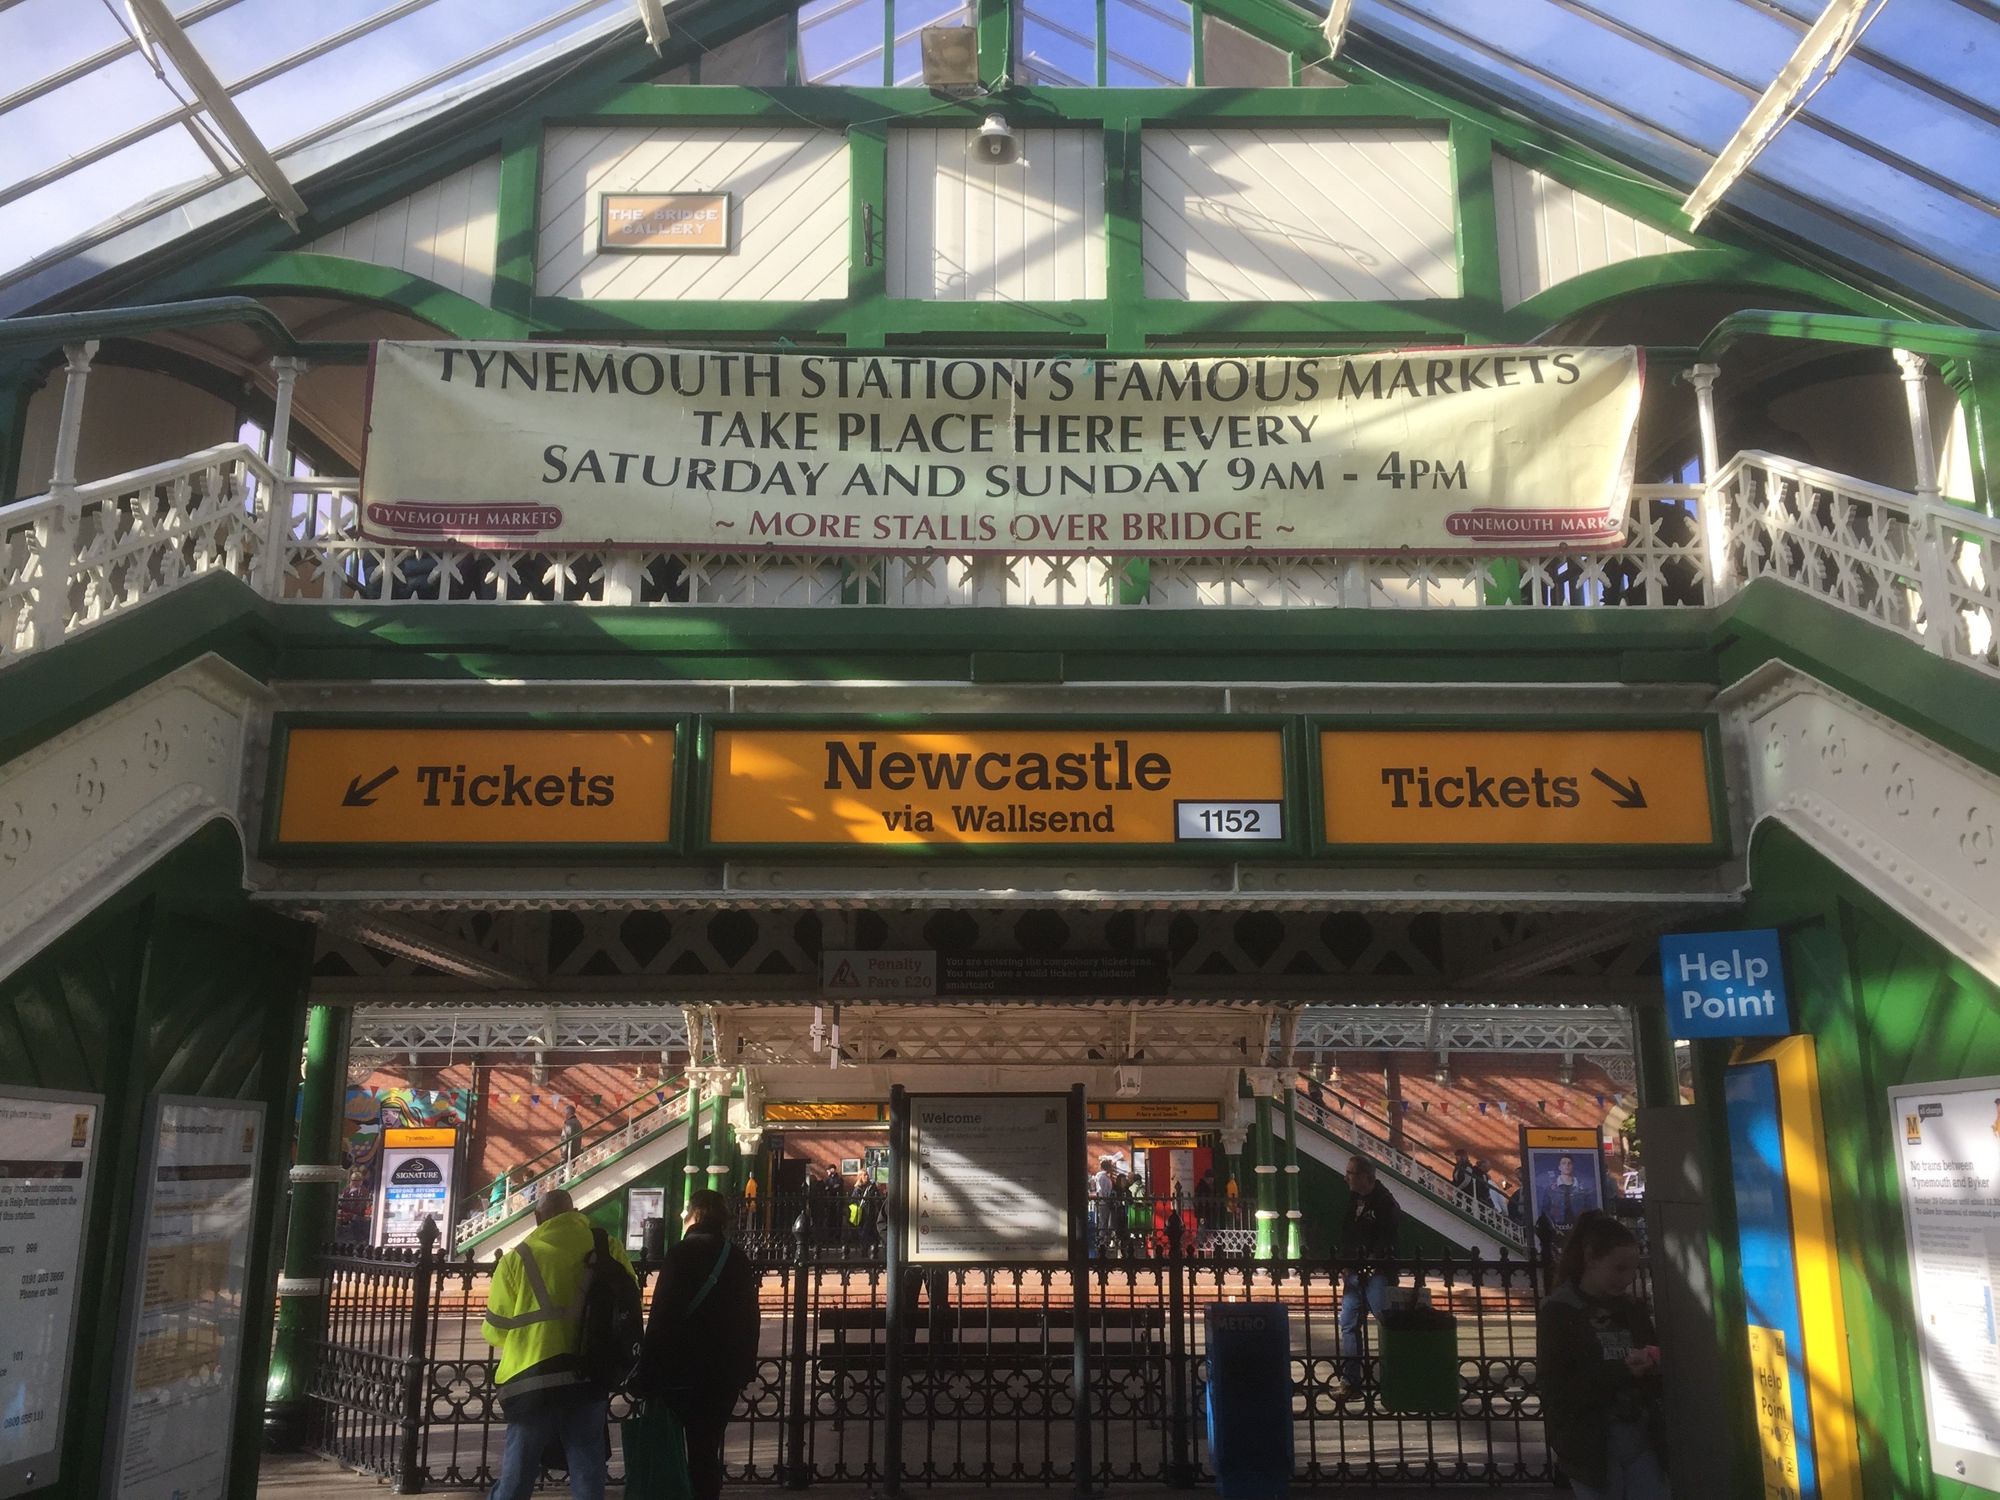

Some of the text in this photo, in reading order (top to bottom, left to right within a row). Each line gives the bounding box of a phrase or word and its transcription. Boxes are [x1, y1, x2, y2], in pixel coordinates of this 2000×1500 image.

[608, 208, 718, 221] THE BRIDGE
[622, 222, 706, 235] GALLERY
[434, 347, 1580, 402] TYNEMOUTH STATION'S FAMOUS MARKETS
[693, 410, 1319, 453] TAKE PLACE HERE EVERY
[542, 444, 829, 496] SATURDAY
[841, 462, 966, 497] AND
[985, 458, 1208, 498] SUNDAY
[1227, 457, 1325, 491] 9AM
[1376, 450, 1468, 490] 4PM
[373, 506, 557, 525] TYNEMOUTH MARKETS
[1452, 514, 1609, 531] TYNEMOUTH MARK
[749, 510, 861, 538] MORE
[873, 514, 997, 541] STALLS
[1009, 513, 1109, 541] OVER
[1122, 511, 1262, 541] BRIDGE
[823, 740, 1172, 792] Newcastle
[417, 764, 615, 807] Tickets
[1382, 766, 1580, 808] Tickets
[882, 804, 1115, 833] via Wallsend
[1199, 809, 1262, 833] 1152
[868, 958, 922, 972] Penalty
[945, 957, 963, 967] You
[966, 958, 981, 966] are
[984, 957, 1023, 968] entering
[1026, 957, 1040, 966] the
[1043, 957, 1098, 968] compulsory
[1101, 957, 1128, 966] ticket
[1680, 949, 1769, 987] Help
[868, 975, 932, 988] Fare £20
[945, 968, 963, 977] You
[966, 968, 988, 977] must
[991, 968, 1013, 977] have
[1025, 968, 1047, 977] valid
[1050, 968, 1076, 977] ticket
[1091, 968, 1136, 978] validated
[945, 981, 994, 989] smartcard
[1682, 987, 1776, 1019] Point
[921, 1112, 982, 1124] Welcome
[1906, 1116, 1919, 1134] M
[1149, 1138, 1190, 1146] Tynemouth
[1910, 1160, 1974, 1171] No trains between
[395, 1171, 439, 1179] SIGNATURE
[1911, 1176, 1989, 1190] Tynemouth and Byker
[9, 1197, 23, 1208] Help
[23, 1197, 39, 1207] Point
[1758, 1366, 1783, 1392] Help
[1761, 1396, 1787, 1421] Point
